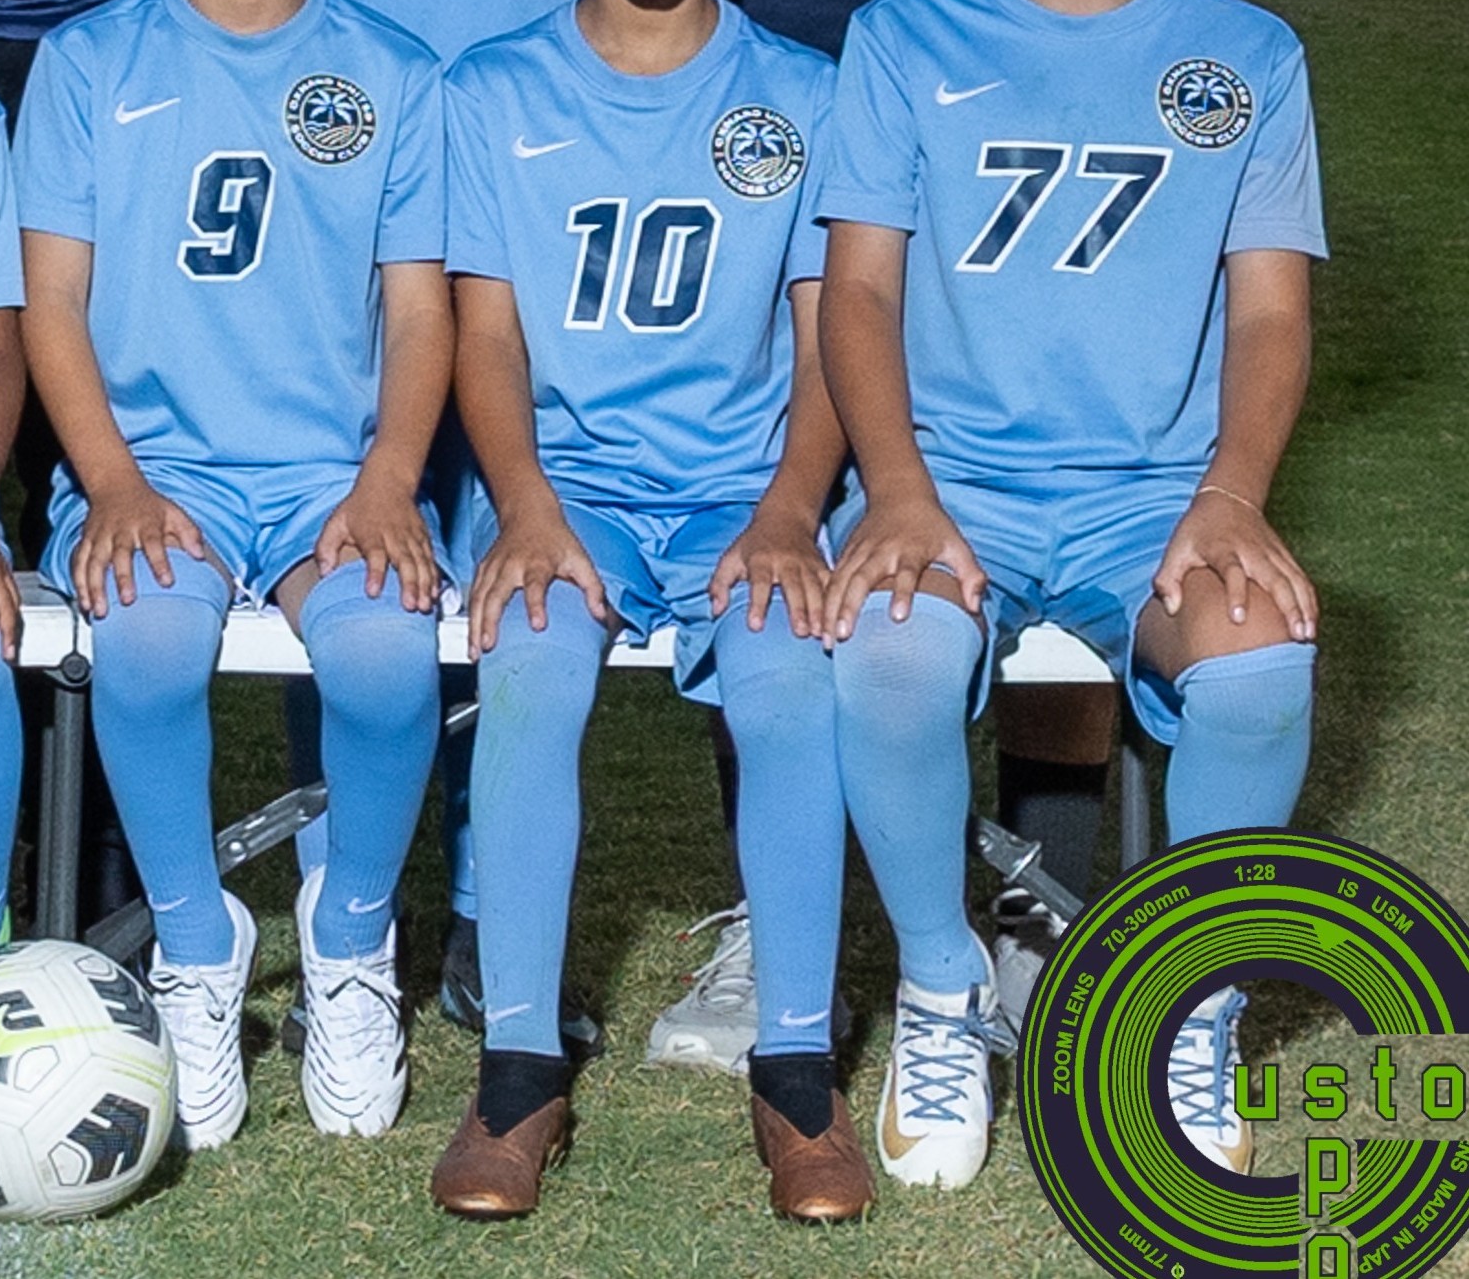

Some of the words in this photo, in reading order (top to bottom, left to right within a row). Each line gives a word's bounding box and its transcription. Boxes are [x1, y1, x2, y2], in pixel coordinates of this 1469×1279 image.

[336, 80, 373, 123] UNITED
[1210, 63, 1249, 104] UNITED
[290, 124, 335, 161] SOCCER
[337, 134, 370, 160] CLUB
[764, 112, 801, 153] UNITED
[1165, 108, 1214, 145] SOCCER
[1216, 117, 1246, 144] CLUB
[717, 160, 767, 195] SOCCER
[767, 163, 799, 191] CLUB
[177, 150, 276, 281] 9
[954, 140, 1173, 274] 77
[563, 197, 723, 333] 10
